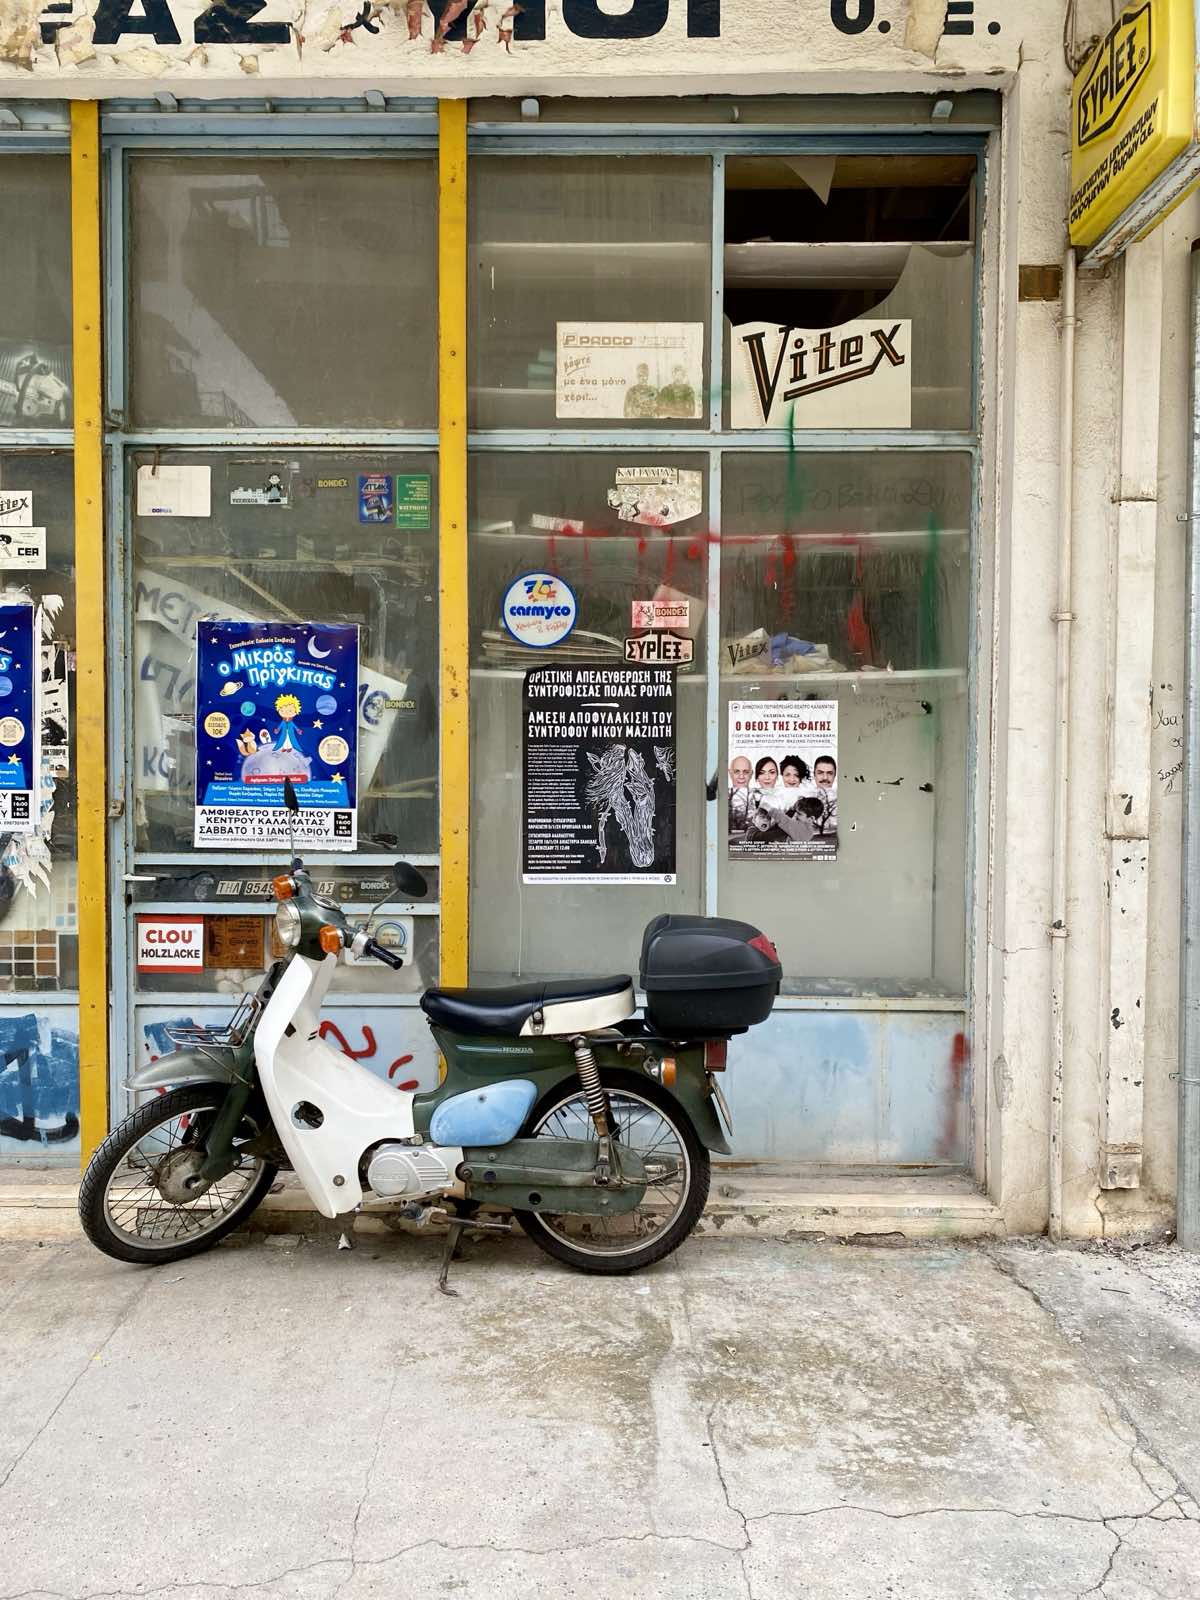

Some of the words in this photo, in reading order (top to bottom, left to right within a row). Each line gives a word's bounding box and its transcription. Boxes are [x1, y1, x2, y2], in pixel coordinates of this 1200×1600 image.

[742, 323, 905, 425] Vitex
[0, 496, 29, 512] itex
[509, 605, 571, 620] carmyco
[655, 606, 688, 617] BONDEX
[249, 665, 335, 690] Πρίγκιπας
[528, 670, 573, 683] ΟΡΙΣΤΙΚΗ
[575, 671, 651, 683] ΑΠΕΛΕΥΘΕΡΩΣΗ
[654, 671, 673, 683] ΤΗΣ
[528, 684, 601, 697] ΣΥΝΤΡΟΦΙΣΣΑΣ
[604, 685, 637, 697] ΠΟΛΑΣ
[640, 685, 673, 697] ΡΟΥΠΑ
[528, 711, 566, 724] ΑΜΕΣΗ
[569, 711, 649, 724] ΑΠΟΦΥΛΑΚΙΣΗ
[652, 711, 673, 724] ΤΟΥ
[528, 725, 588, 738] ΣΥΝΤΡΟΦΟΥ
[591, 725, 623, 738] ΝΙΚΟΥ
[626, 725, 672, 738] ΜΑΖΙΩΤΗ
[735, 721, 742, 731] Ο
[745, 721, 769, 731] ΘΕΟΣ
[772, 721, 790, 731] ΤΗΣ
[793, 721, 832, 731] ΣΦΑΓΗΣ
[200, 809, 269, 817] ΑΜΦΙΘΕΑΤΡΟ
[272, 810, 331, 818] ΕΡΓΑΤΙΚΟΥ
[206, 817, 255, 825] ΚΕΝΤΡΟΥ
[258, 818, 325, 826] ΚΑΛΑΜΑΤΑΣ
[199, 826, 248, 835] ΣΑΒΒΑΤΟ
[252, 826, 264, 835] 13
[267, 827, 330, 836] ΙΑΝΟΥΑΡΙΟΥ
[217, 882, 241, 894] ΤΗΛ
[245, 882, 276, 895] 9549
[360, 880, 391, 890] BONDEX
[145, 929, 193, 944] CLOU
[141, 948, 201, 959] HOLZLACKE
